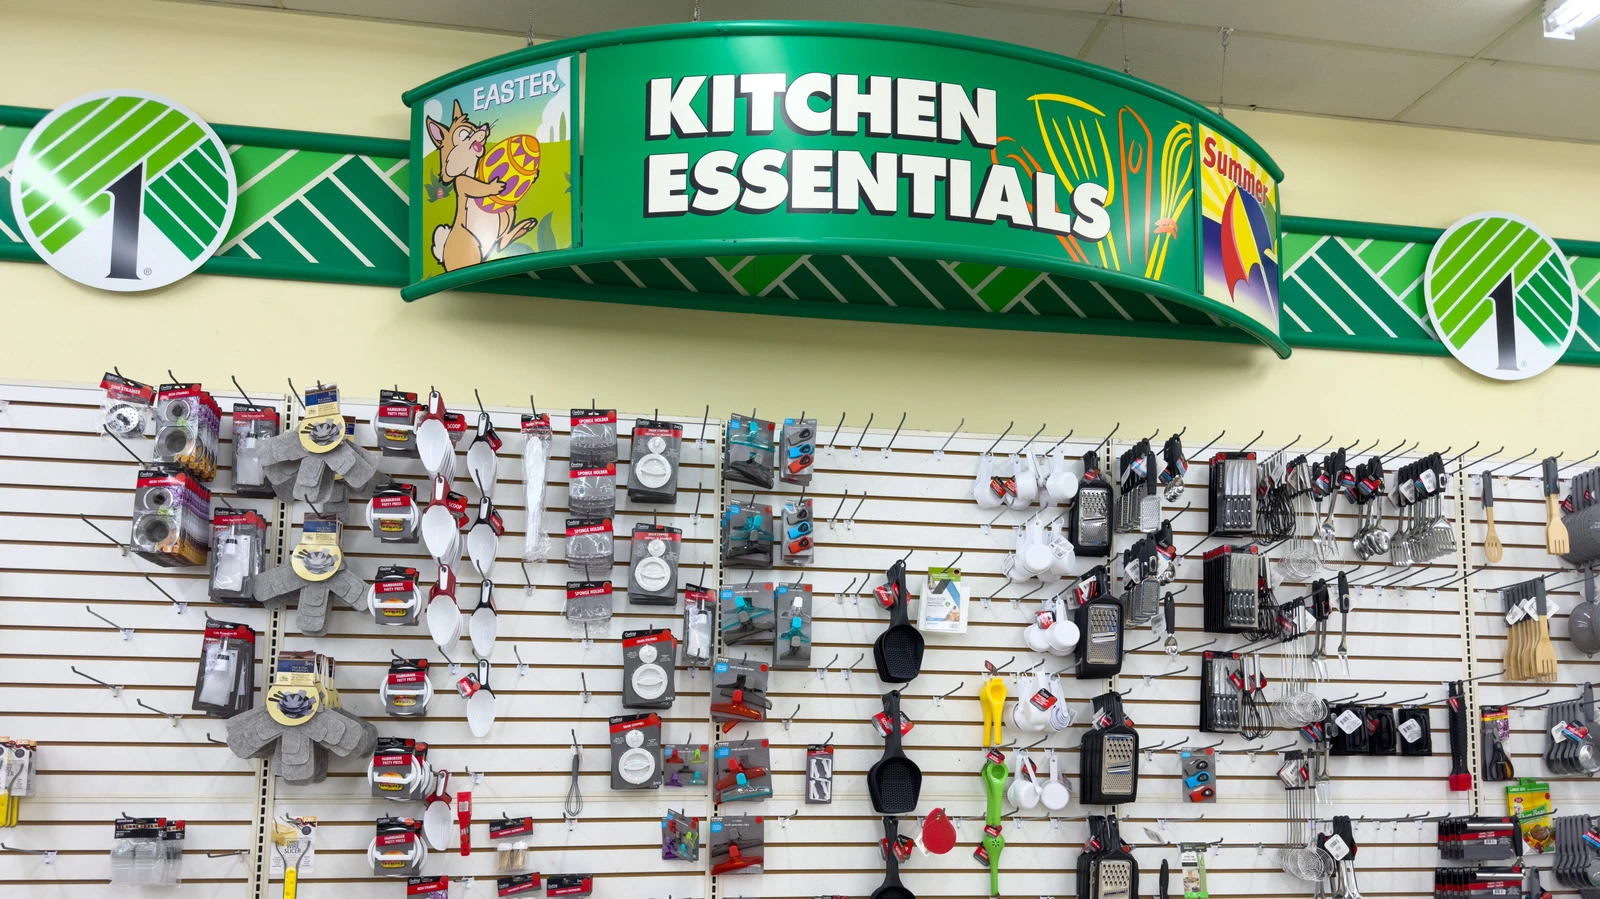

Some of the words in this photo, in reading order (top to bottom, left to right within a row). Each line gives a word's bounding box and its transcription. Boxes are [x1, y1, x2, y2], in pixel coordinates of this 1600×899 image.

[472, 69, 560, 112] EASTER
[645, 72, 997, 147] KITCHEN
[643, 149, 1111, 242] ESSENTIALS
[1203, 136, 1269, 208] Summer
[104, 161, 143, 280] 1
[1487, 271, 1521, 371] 1
[448, 502, 462, 510] SCOOP
